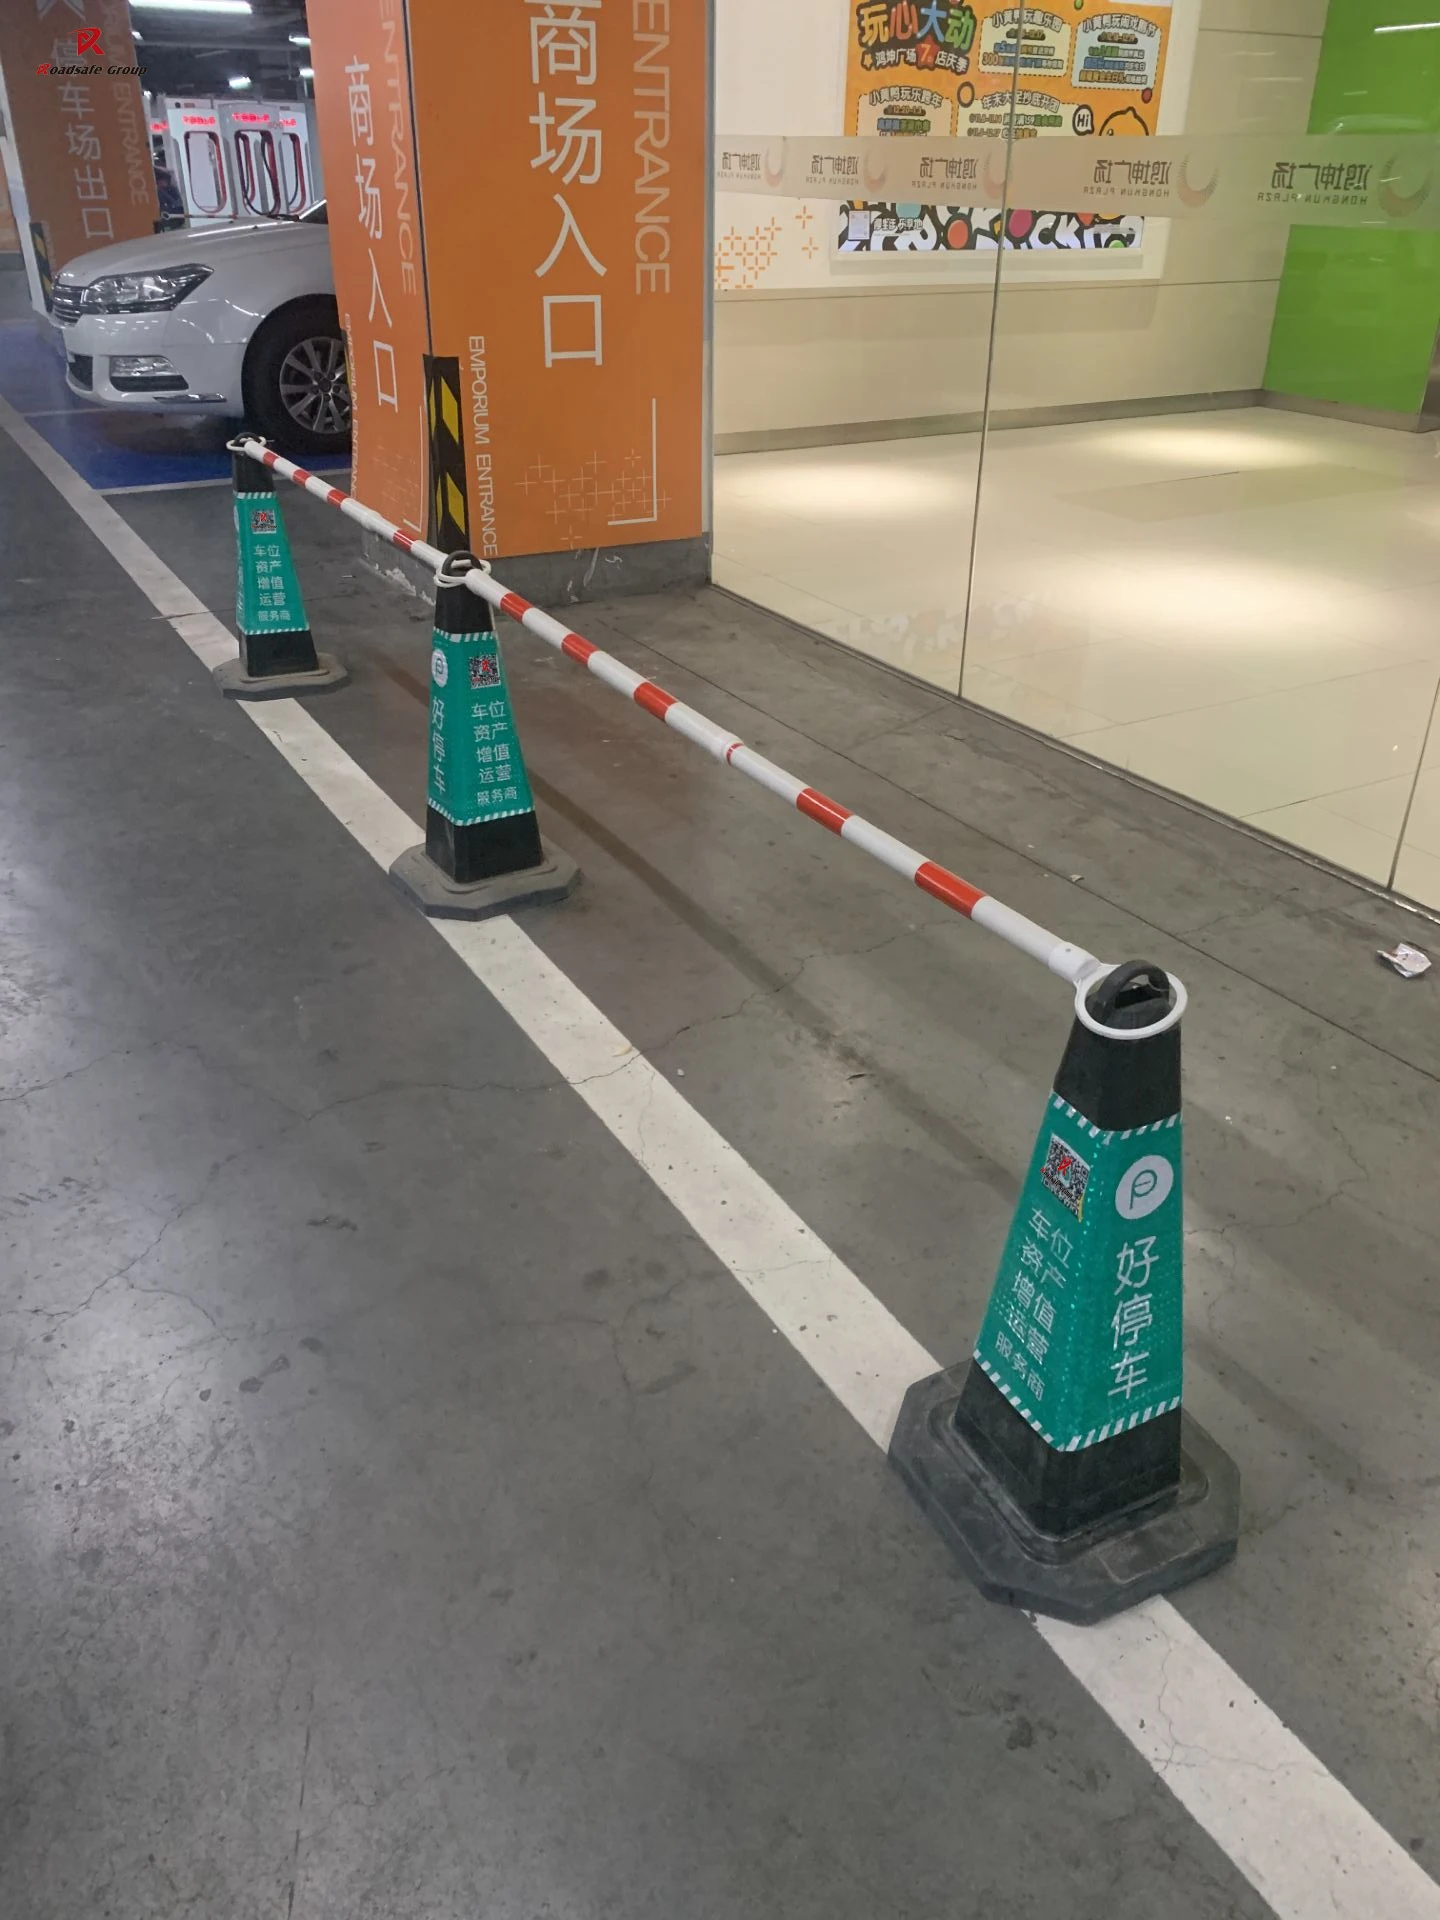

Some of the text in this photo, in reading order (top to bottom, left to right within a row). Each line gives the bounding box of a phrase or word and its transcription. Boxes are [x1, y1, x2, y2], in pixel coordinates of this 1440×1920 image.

[861, 0, 975, 50] 玩心大动
[632, 0, 671, 295] ENTRANCE
[1077, 113, 1089, 127] Hi
[522, 0, 607, 368] 商场入口
[344, 55, 401, 412] 商场入口
[469, 335, 498, 557] EMPORIUM ENTRANCE
[471, 700, 506, 720] 车位
[473, 722, 508, 742] 资产
[476, 744, 510, 763] 增值
[479, 764, 512, 784] 运营
[477, 786, 517, 806] 服务商
[1021, 1237, 1067, 1289] 资产
[1029, 1207, 1073, 1268] 车位
[1012, 1270, 1057, 1334] 增值
[1107, 1235, 1160, 1400] 好停车
[1006, 1302, 1049, 1366] 运营
[995, 1330, 1045, 1401] 服务商
